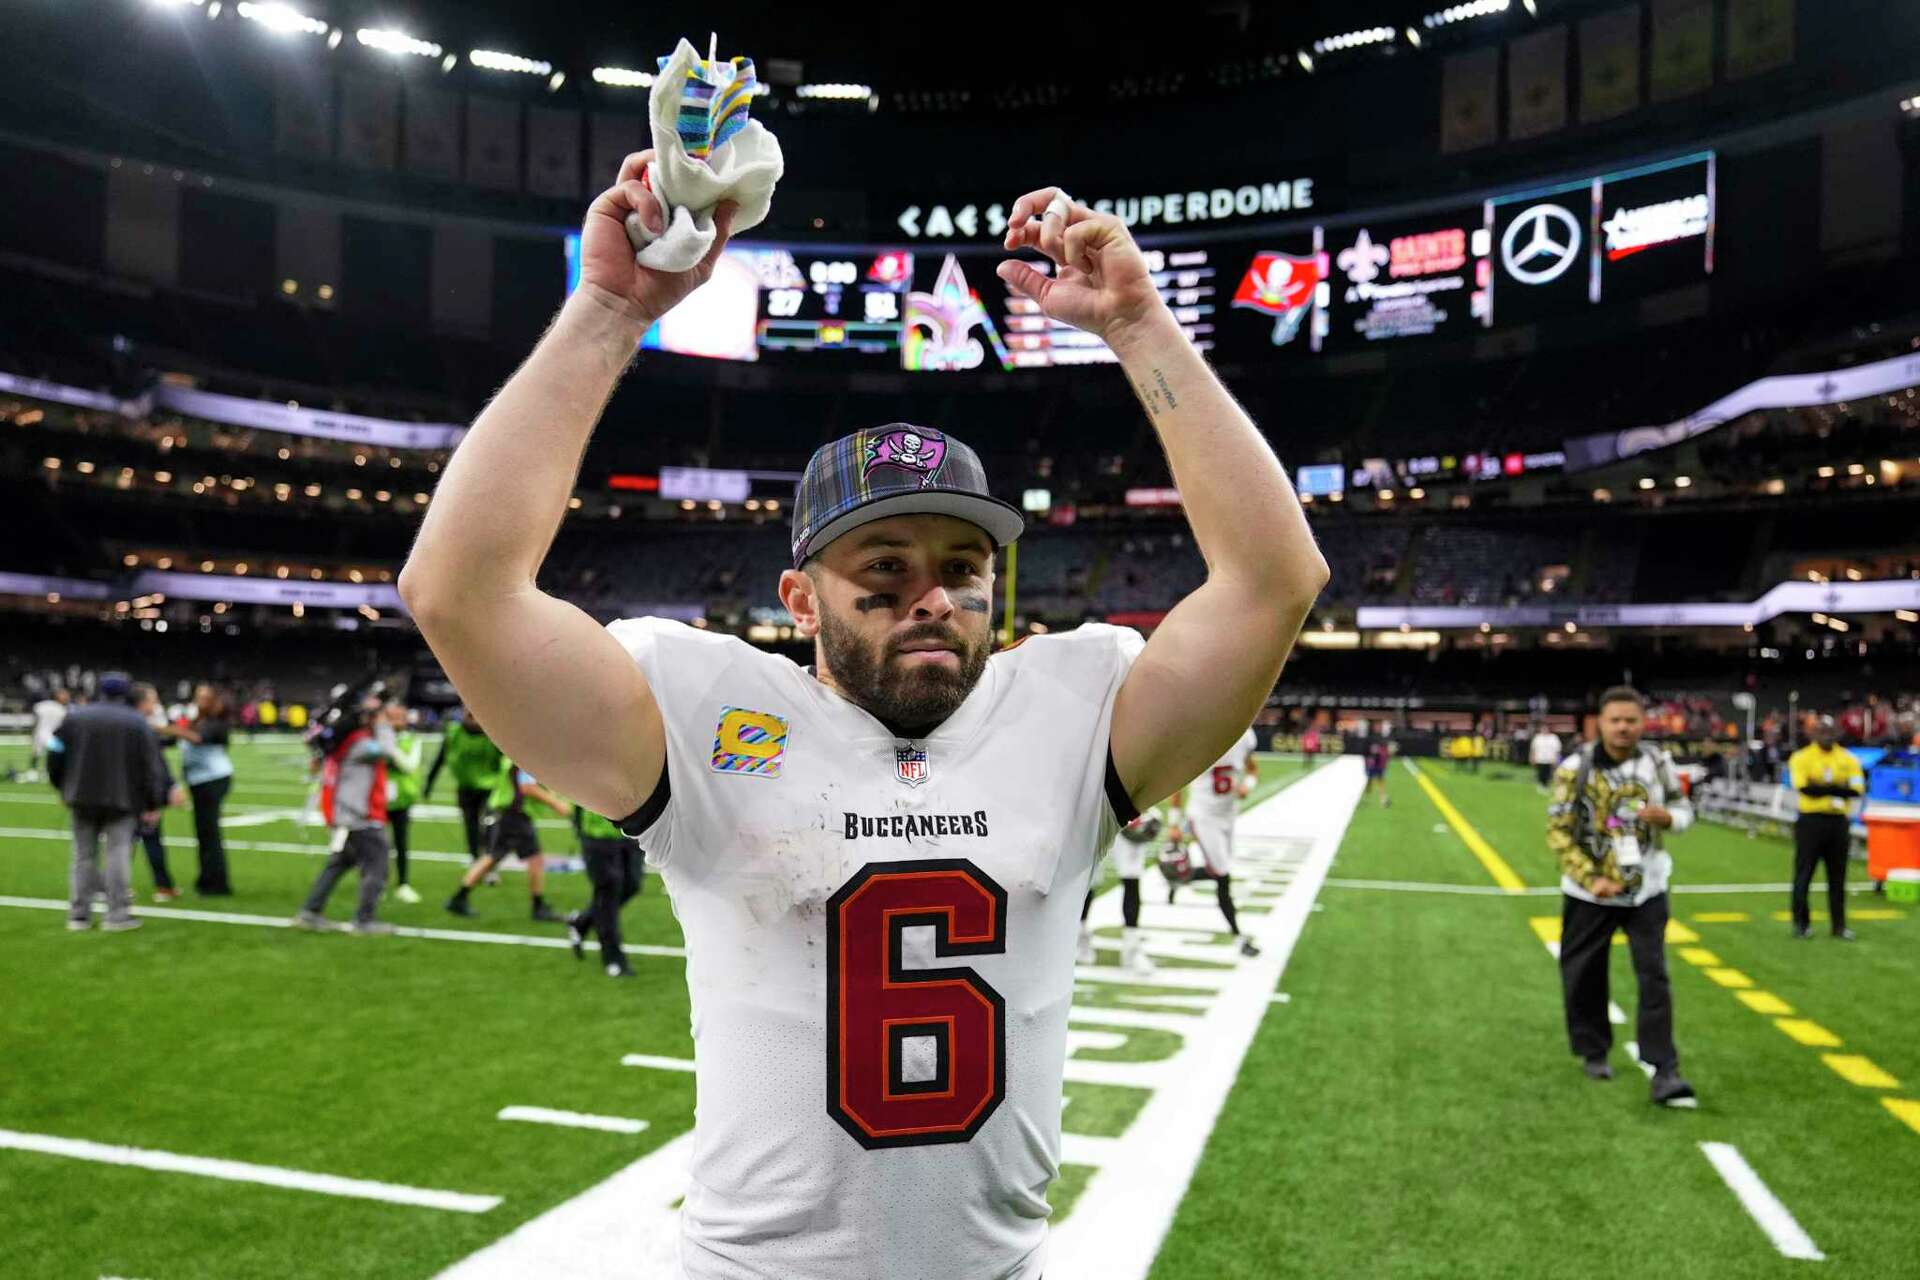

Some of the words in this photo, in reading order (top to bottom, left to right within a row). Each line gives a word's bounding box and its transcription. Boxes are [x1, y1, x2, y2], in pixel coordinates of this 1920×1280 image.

[719, 710, 786, 758] C
[900, 761, 926, 778] NFL
[844, 810, 988, 843] BUCCANEERS
[826, 858, 1008, 1150] 6
